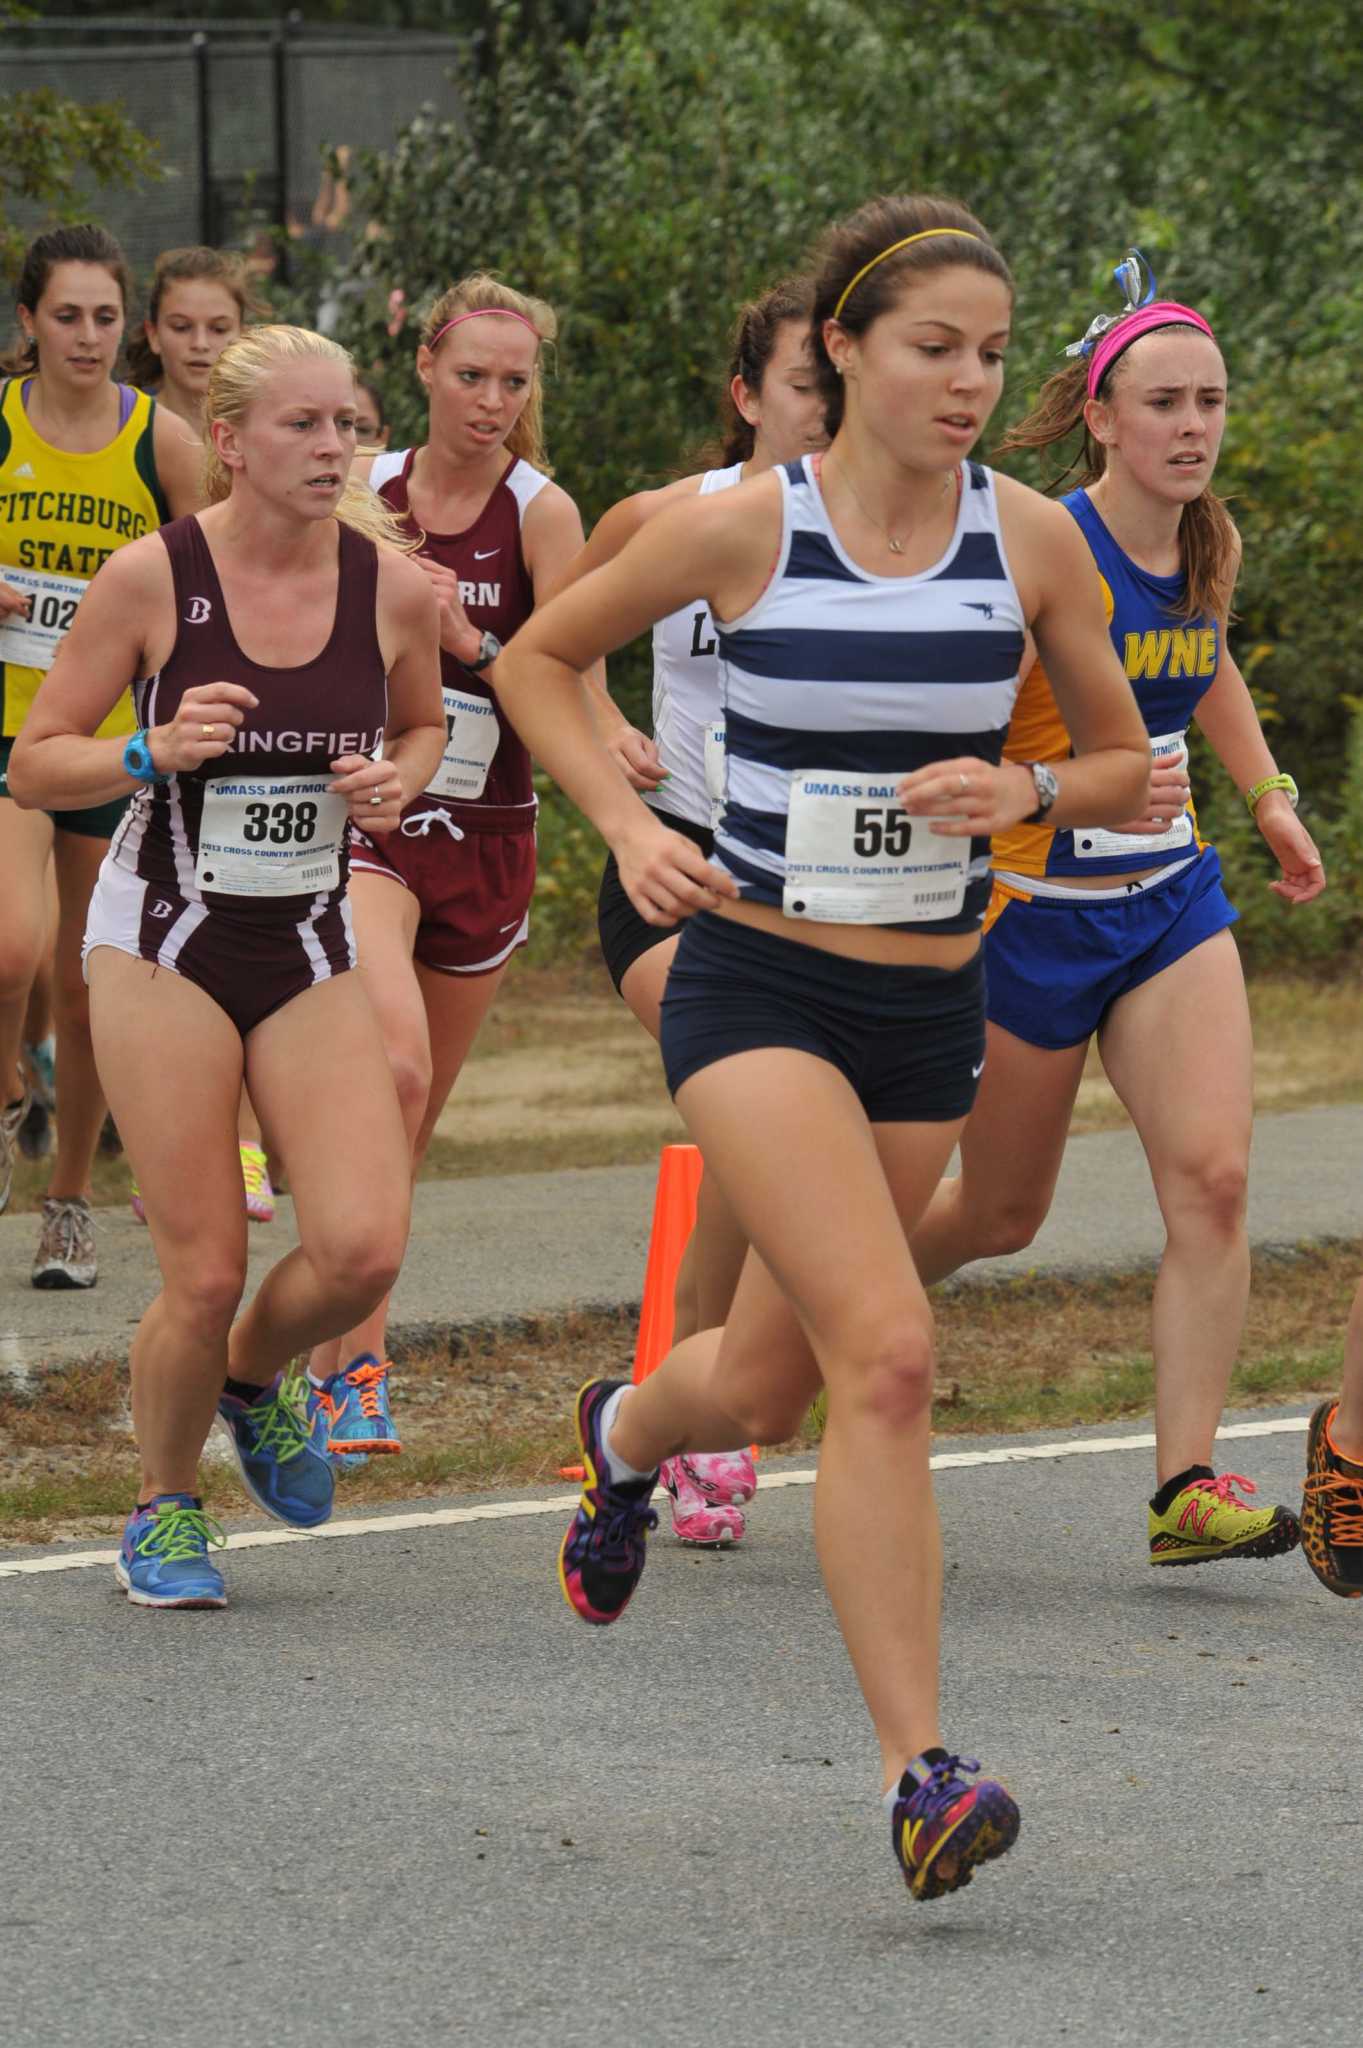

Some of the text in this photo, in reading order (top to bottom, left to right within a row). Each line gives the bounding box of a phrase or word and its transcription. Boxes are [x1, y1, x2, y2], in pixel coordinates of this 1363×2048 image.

[25, 593, 78, 630] 102
[1124, 629, 1217, 680] WNE
[225, 726, 384, 756] INGFIELD
[216, 785, 265, 796] UMASS
[804, 783, 862, 797] UMASS
[243, 801, 318, 844] 338
[854, 808, 912, 857] 55
[201, 842, 221, 852] 2013
[223, 846, 252, 856] CROSS
[254, 850, 294, 858] COUNTRY
[787, 861, 962, 876] 2013 CROSS COUNTRY INVITATIONAL
